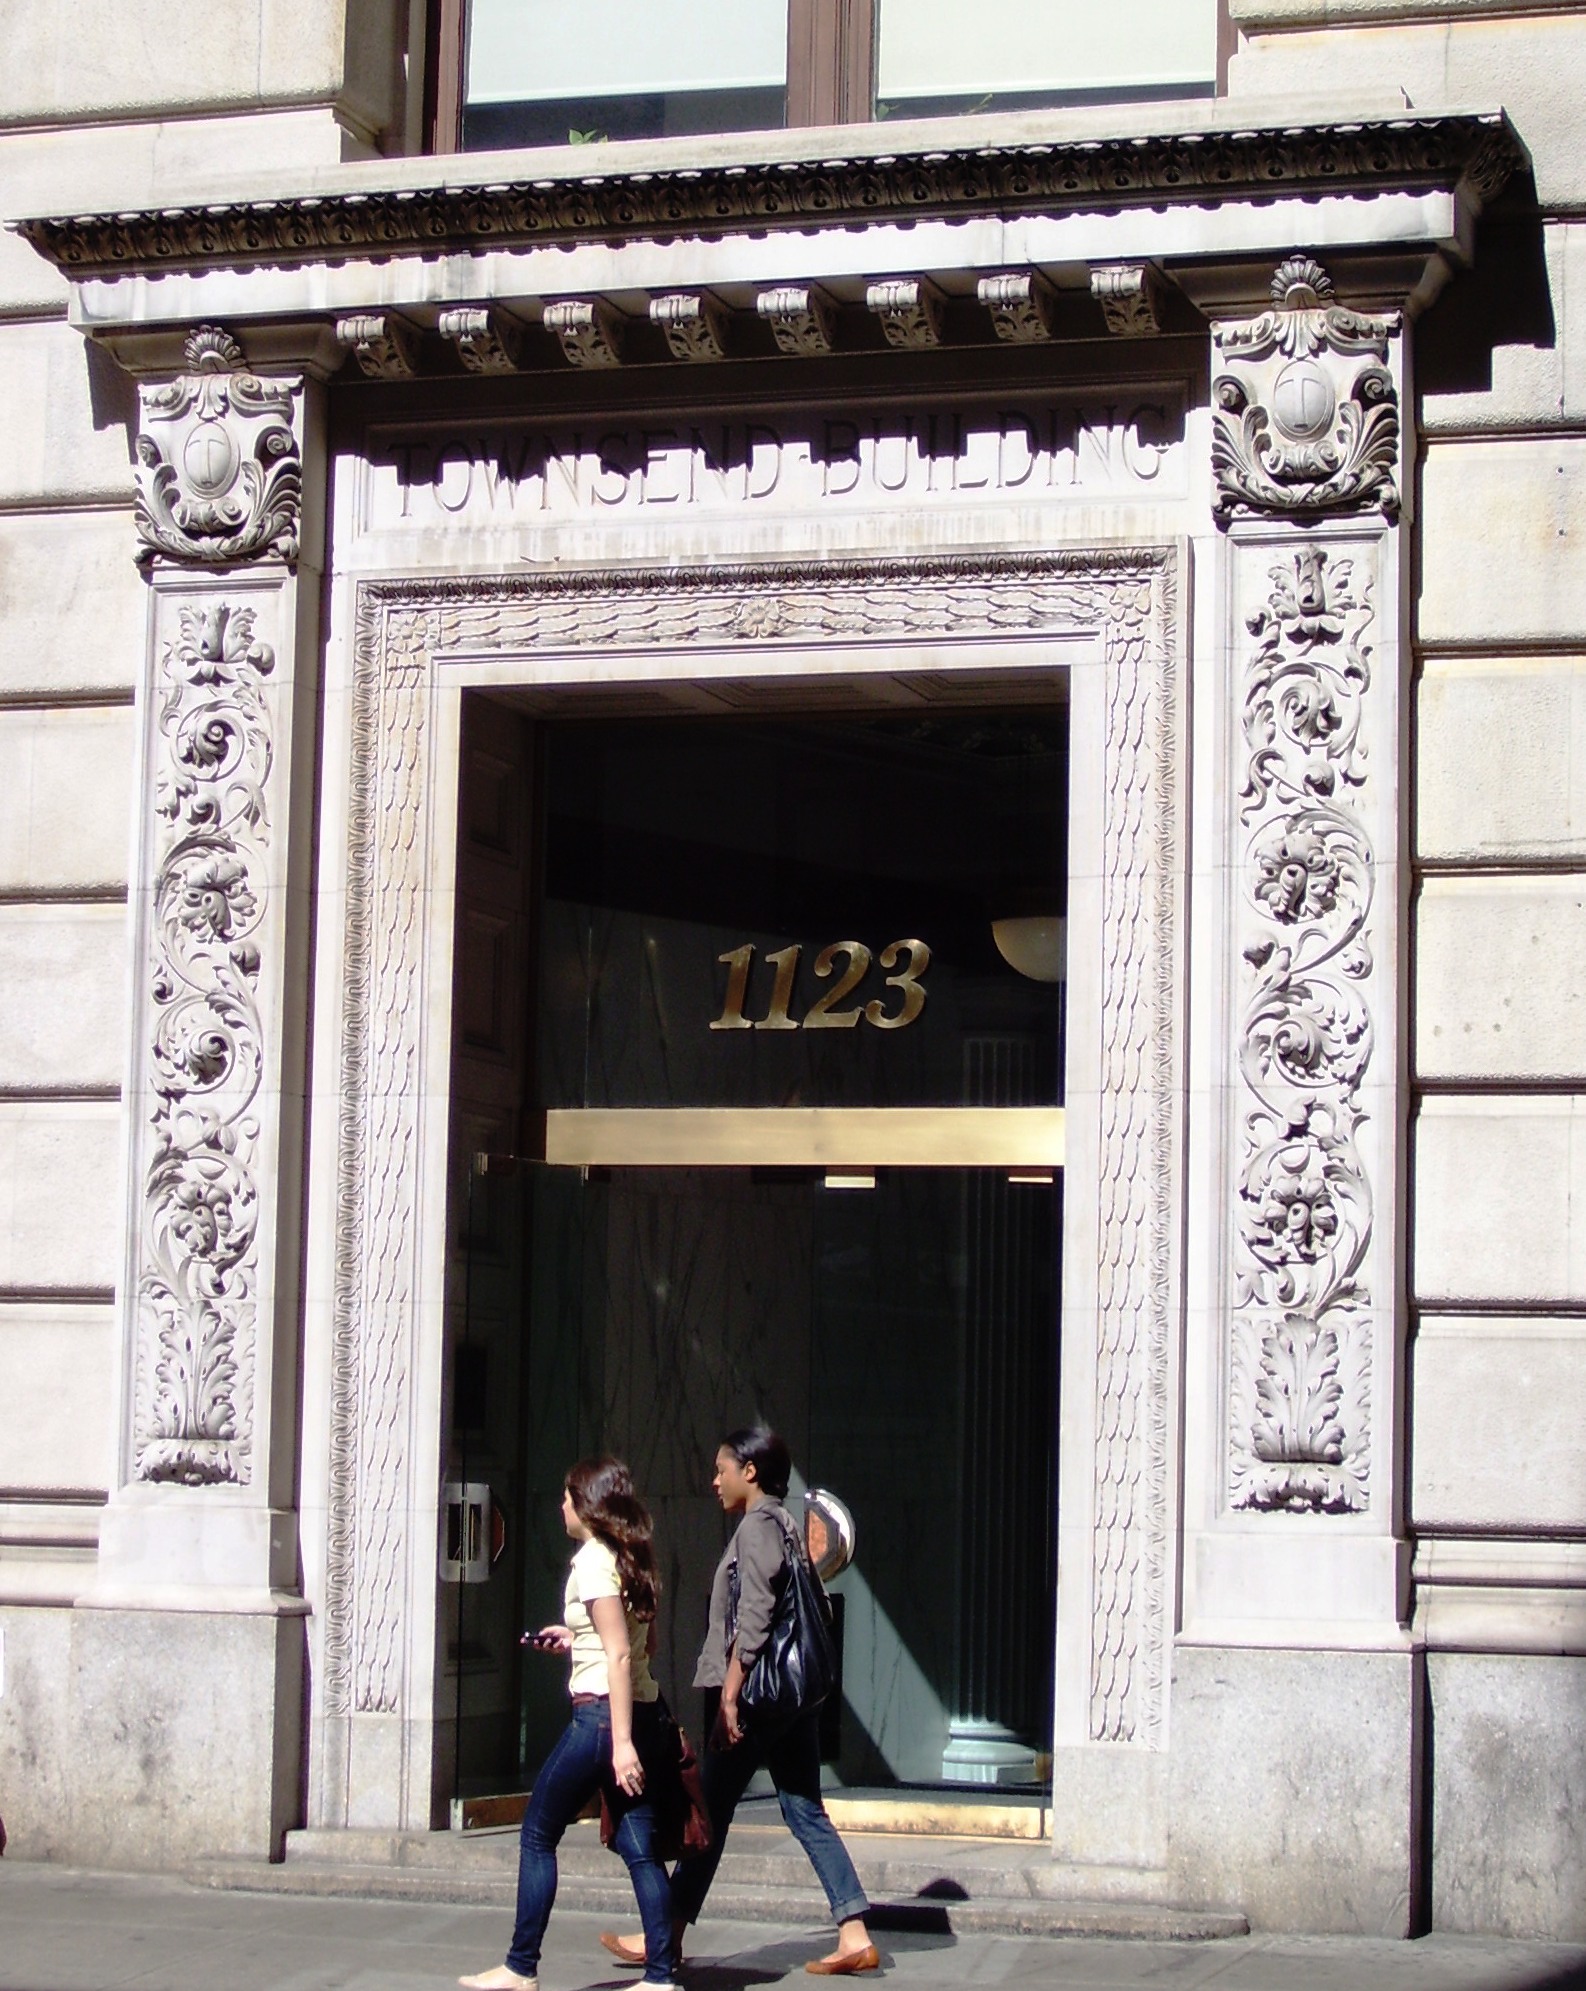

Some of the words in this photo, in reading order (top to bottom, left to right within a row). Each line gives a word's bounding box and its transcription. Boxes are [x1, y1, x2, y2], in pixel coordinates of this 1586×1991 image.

[387, 423, 784, 517] TOWNSEND
[821, 404, 1166, 497] BUILDING
[709, 938, 933, 1030] 1123
